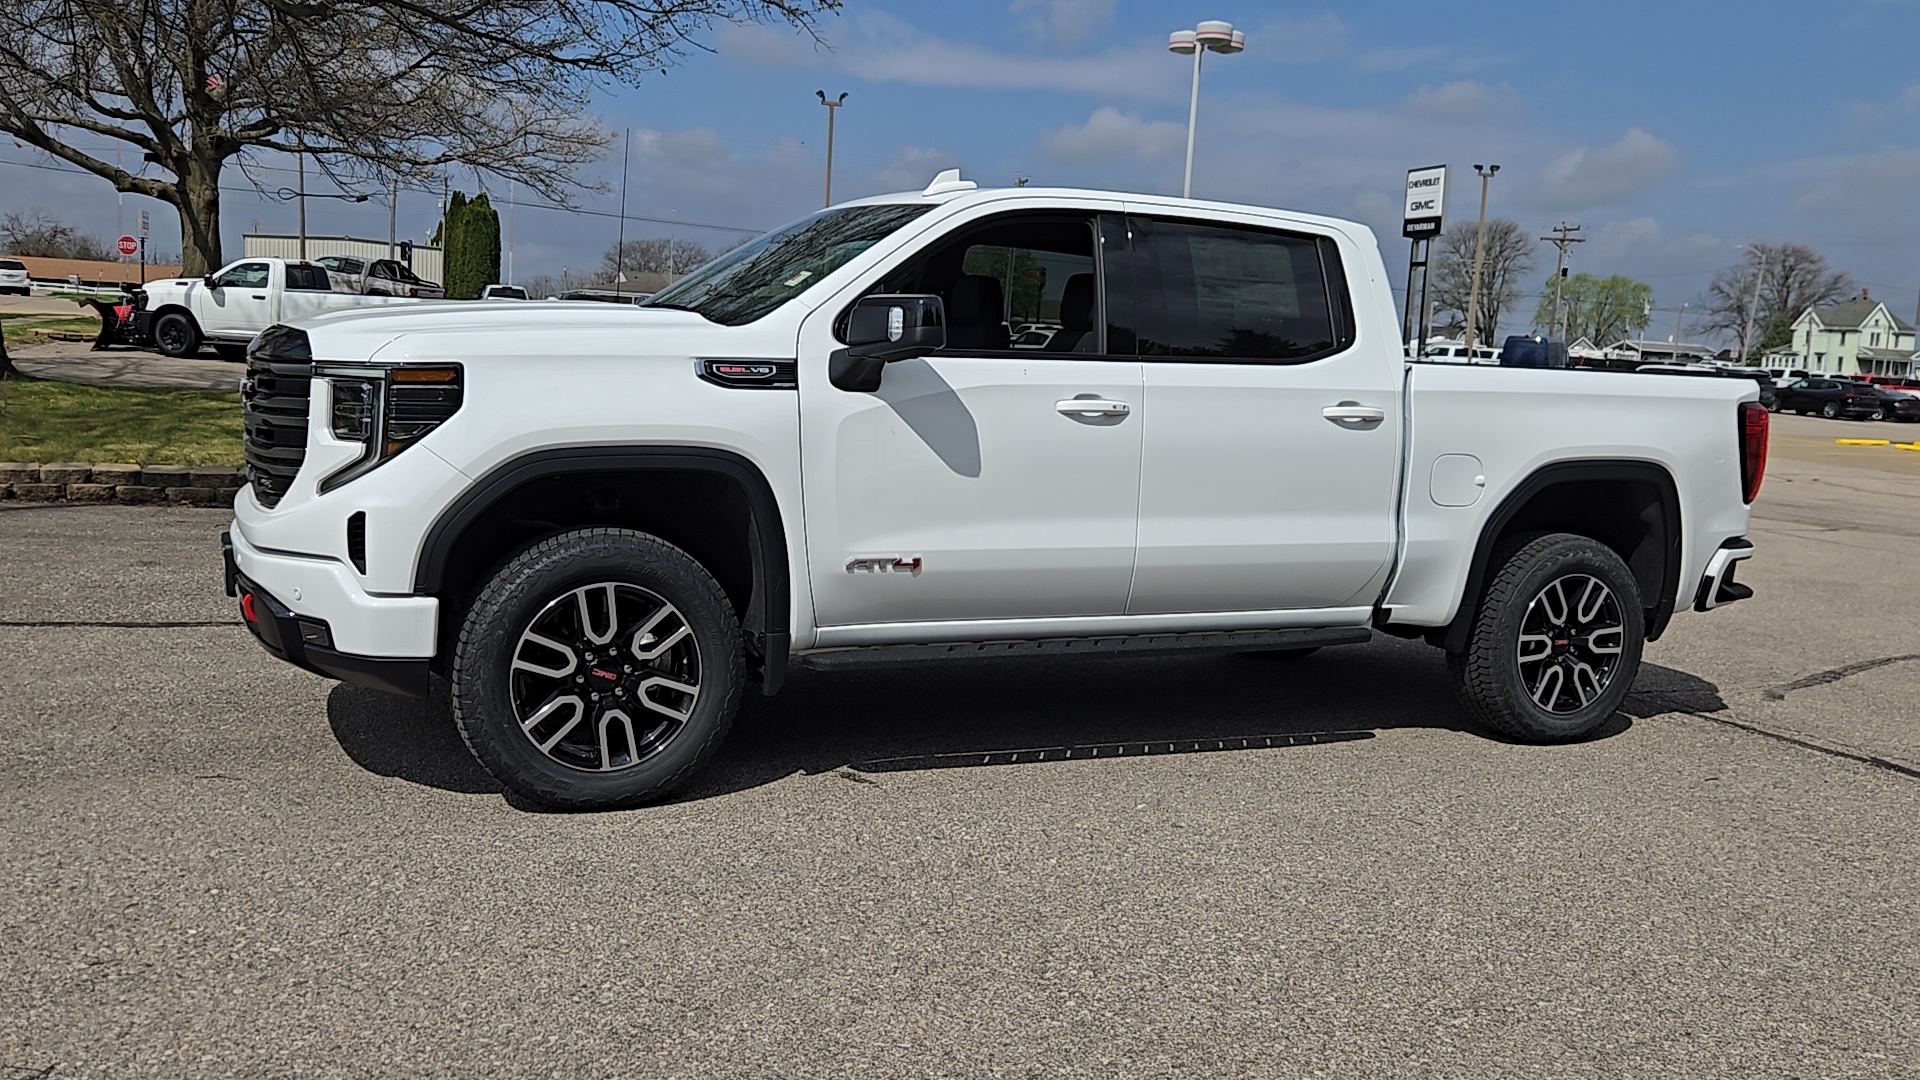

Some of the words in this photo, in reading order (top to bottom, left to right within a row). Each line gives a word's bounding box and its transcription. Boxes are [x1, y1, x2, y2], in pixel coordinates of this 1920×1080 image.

[1408, 177, 1440, 189] CHEVROLET
[1410, 199, 1435, 212] GMC
[118, 241, 137, 250] STOP
[846, 557, 922, 578] AT4
